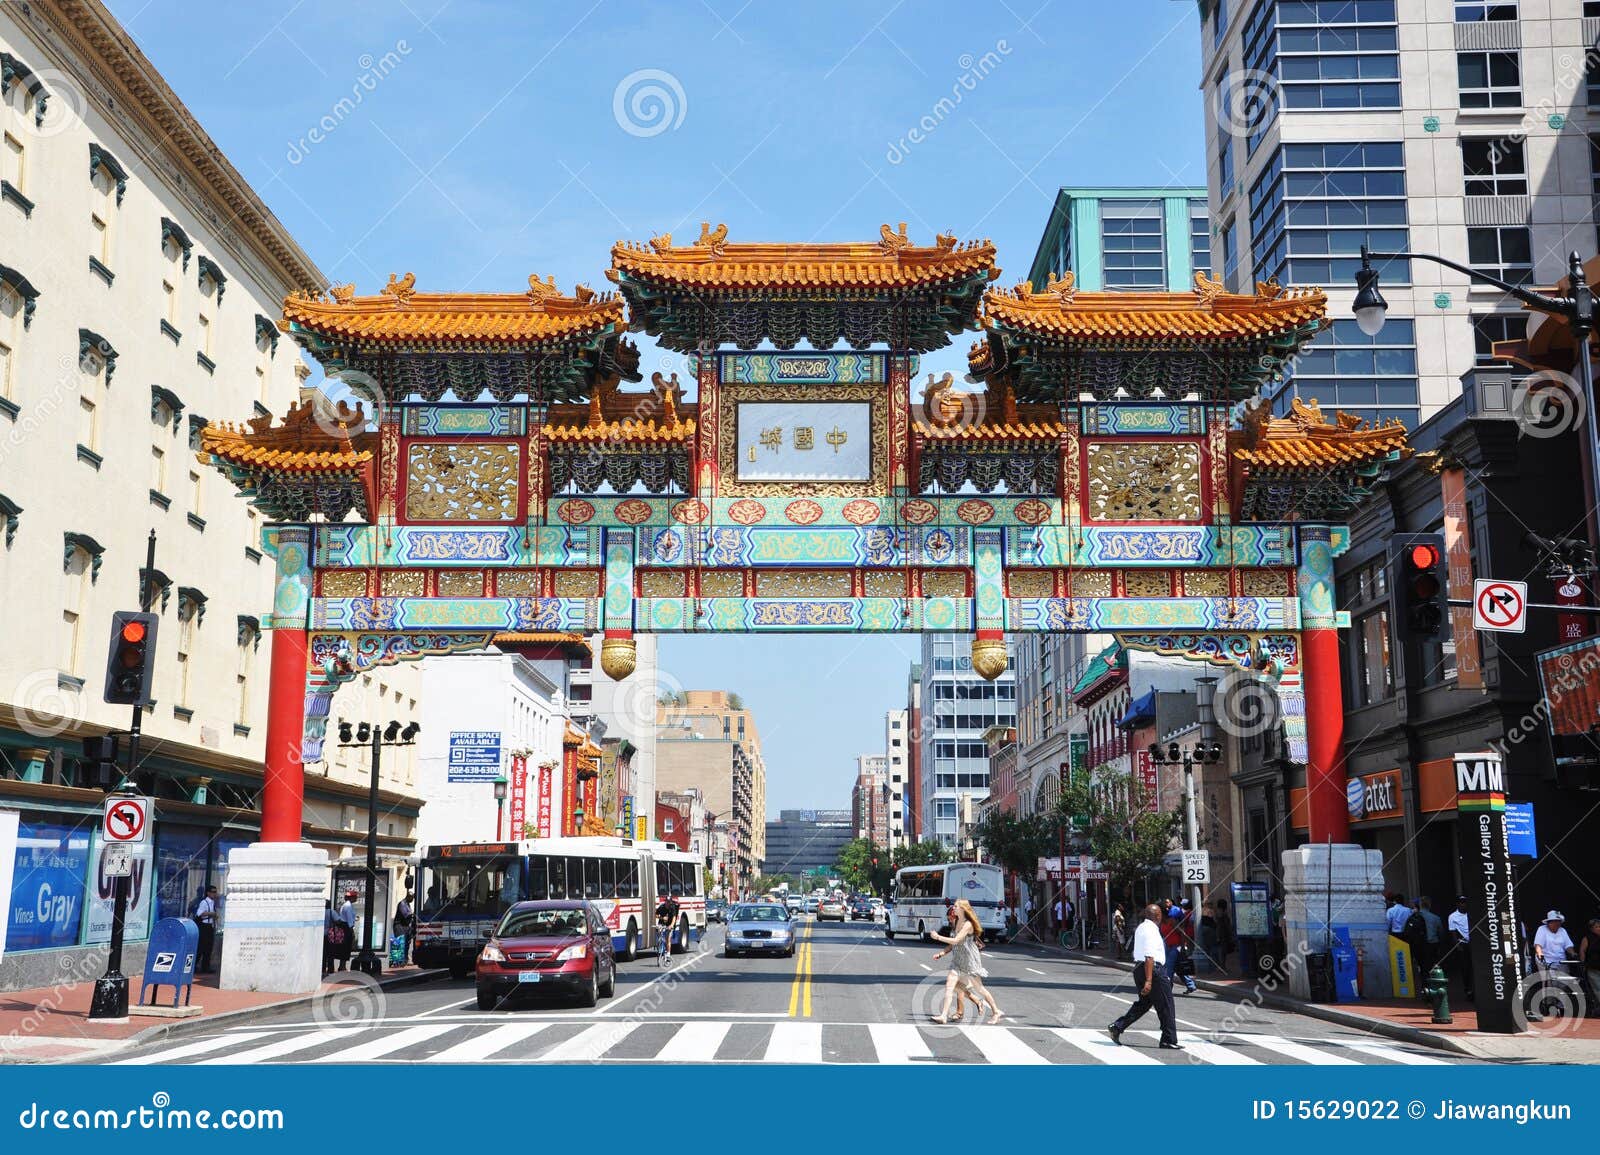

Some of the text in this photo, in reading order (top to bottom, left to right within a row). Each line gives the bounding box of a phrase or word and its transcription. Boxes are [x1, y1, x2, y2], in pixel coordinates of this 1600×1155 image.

[759, 424, 847, 454] 中國城
[1456, 762, 1487, 791] M
[1365, 776, 1393, 812] at&t
[441, 846, 452, 856] X2
[98, 843, 146, 912] Gy
[1187, 868, 1206, 880] 25
[15, 882, 76, 931] Vince Gray
[1479, 814, 1492, 859] Gallery
[1491, 953, 1505, 1000] Station
[1500, 814, 1510, 859] Gallery
[1513, 953, 1524, 1000] Station
[449, 927, 473, 936] metro
